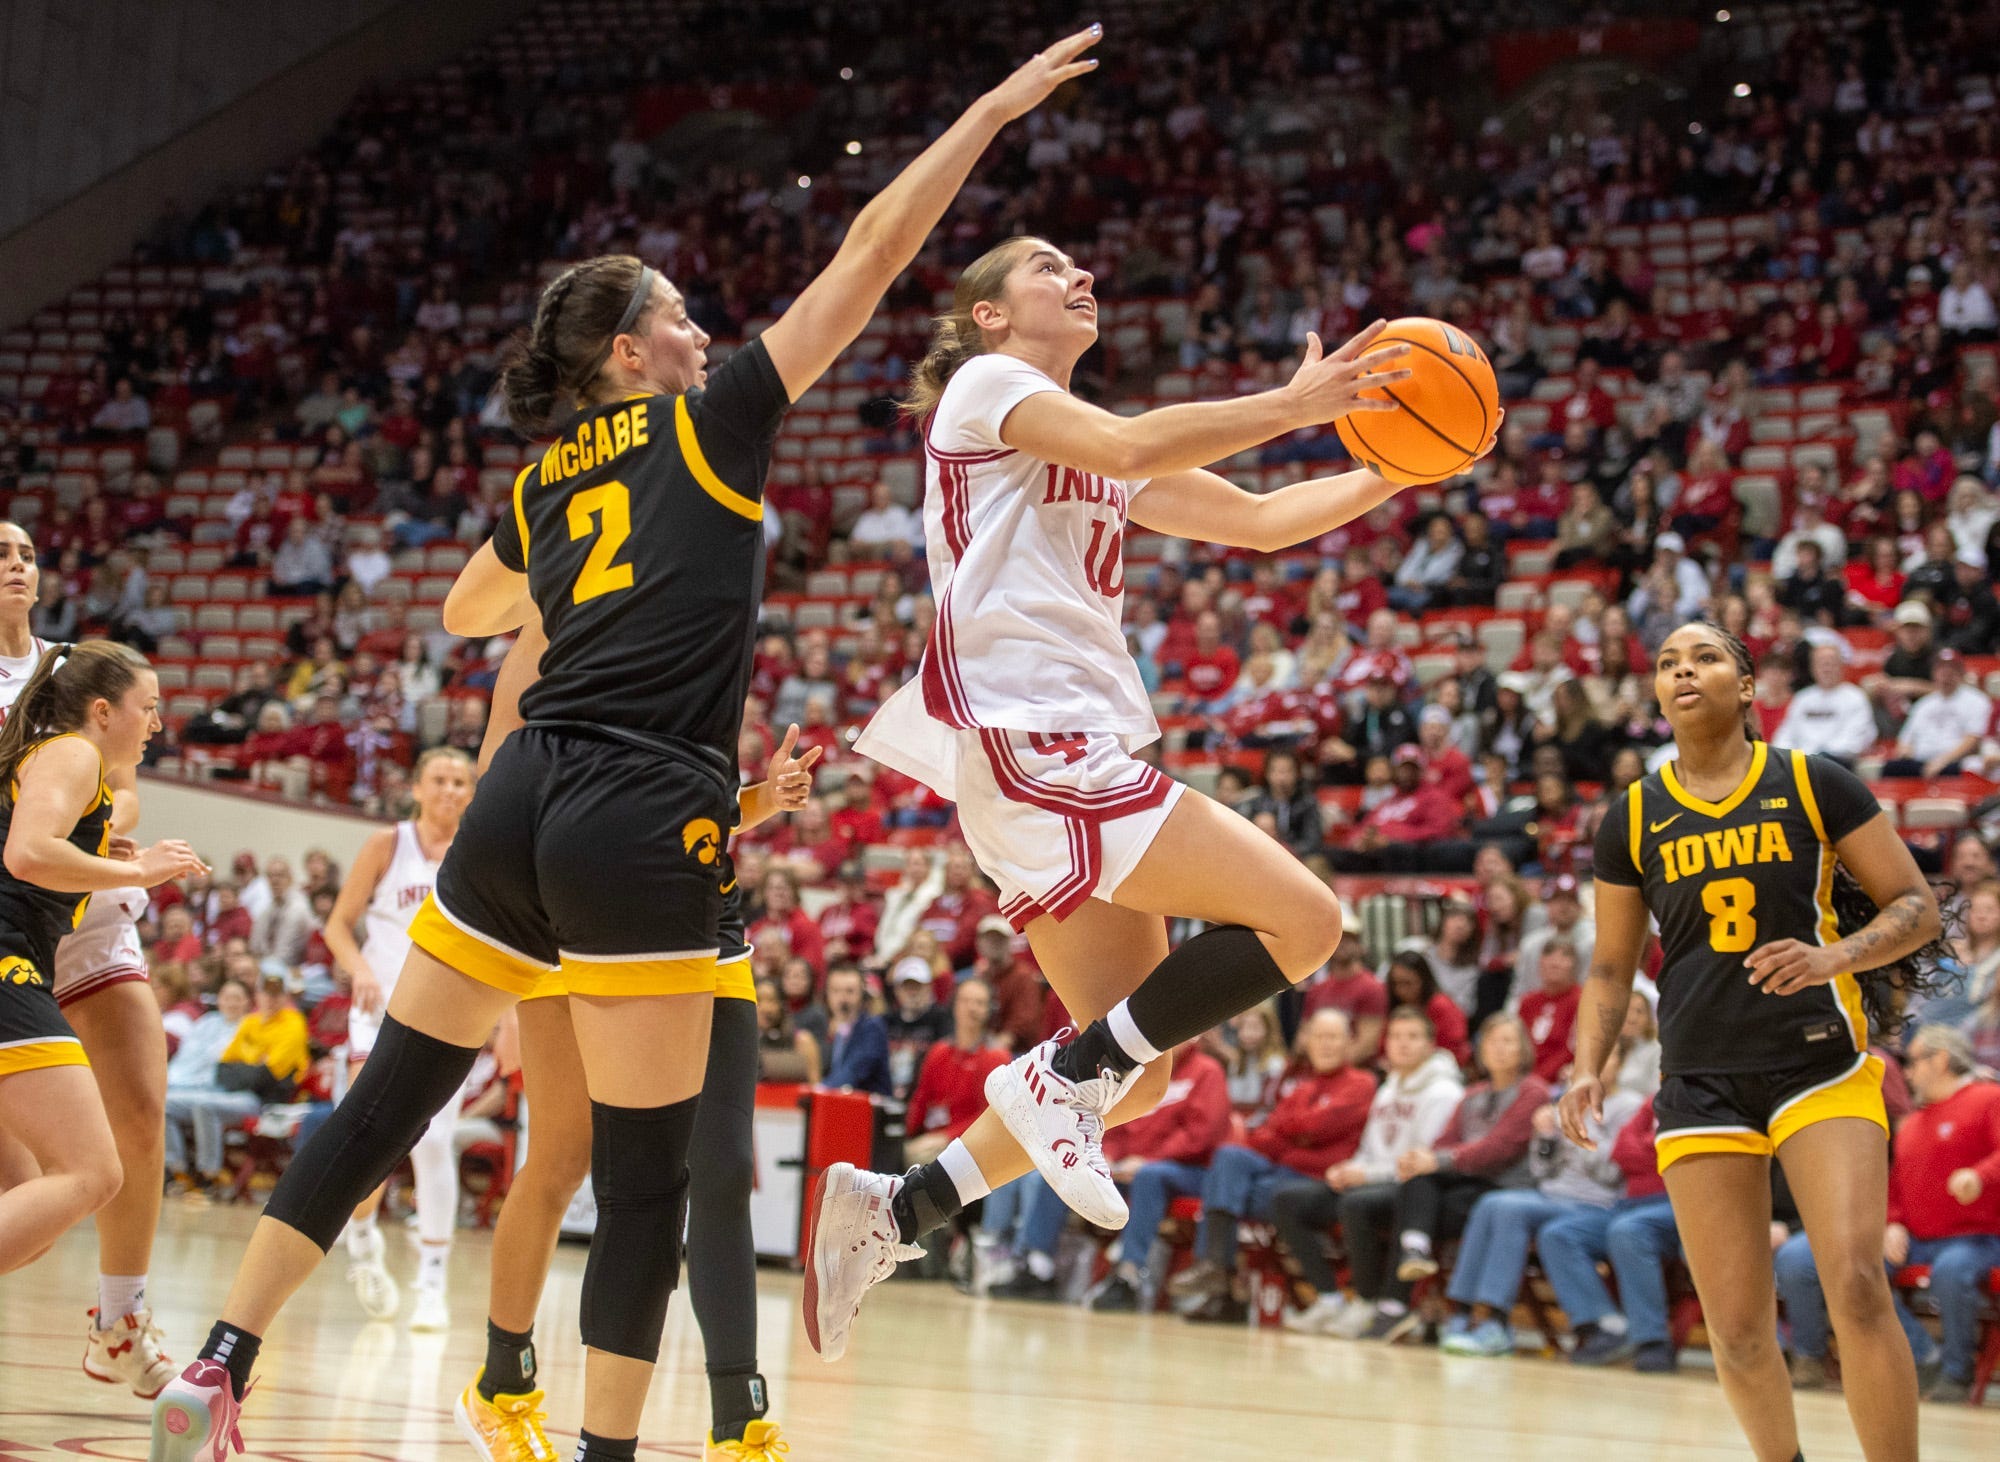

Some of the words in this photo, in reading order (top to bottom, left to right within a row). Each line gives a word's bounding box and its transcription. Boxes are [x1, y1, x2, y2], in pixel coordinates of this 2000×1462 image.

[565, 479, 634, 606] 2
[1084, 518, 1125, 599] 10
[1658, 821, 1794, 884] IOWA
[1701, 876, 1757, 953] 8
